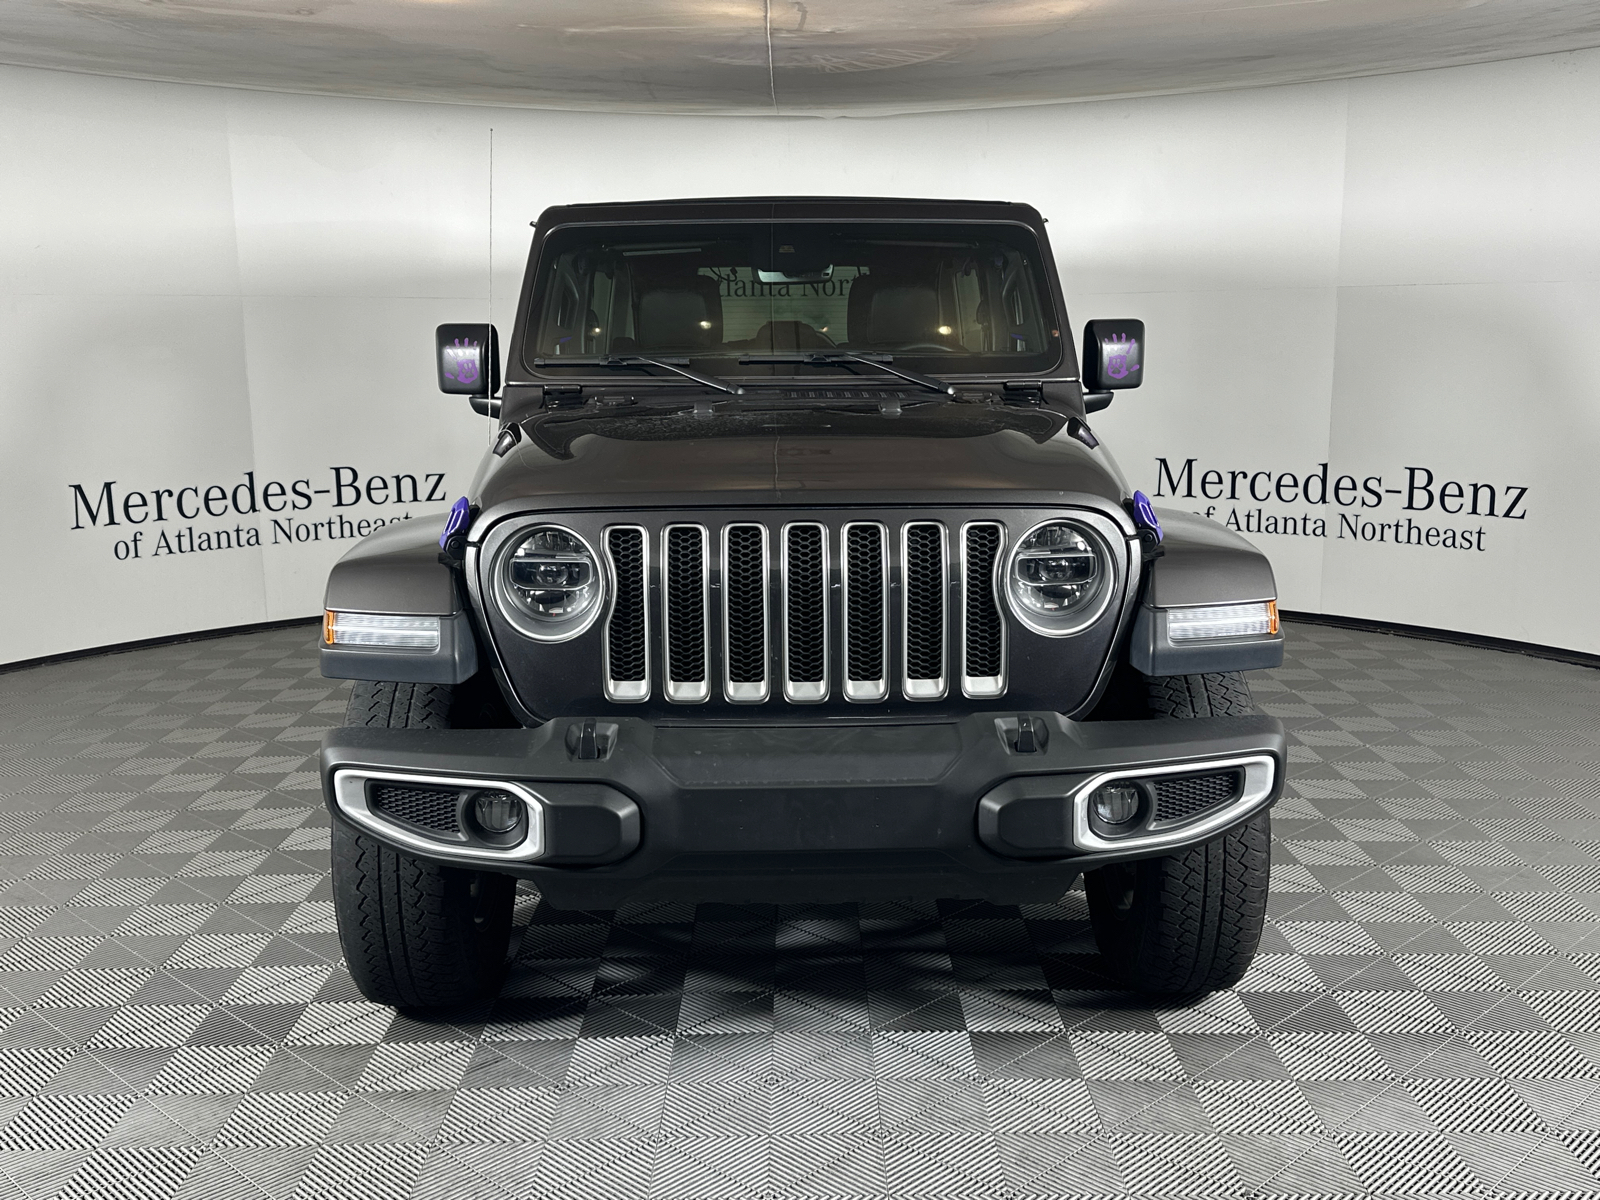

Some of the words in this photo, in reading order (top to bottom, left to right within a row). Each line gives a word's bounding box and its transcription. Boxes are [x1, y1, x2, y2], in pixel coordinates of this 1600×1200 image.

[720, 273, 791, 297] lanta
[801, 275, 857, 297] Nor
[68, 466, 448, 531] Mercedes-Benz
[1152, 457, 1529, 520] Mercedes-Benz
[113, 531, 144, 561] of
[151, 523, 262, 557] Atlanta
[1225, 506, 1328, 538] Atlanta
[1337, 512, 1487, 552] Northeast
